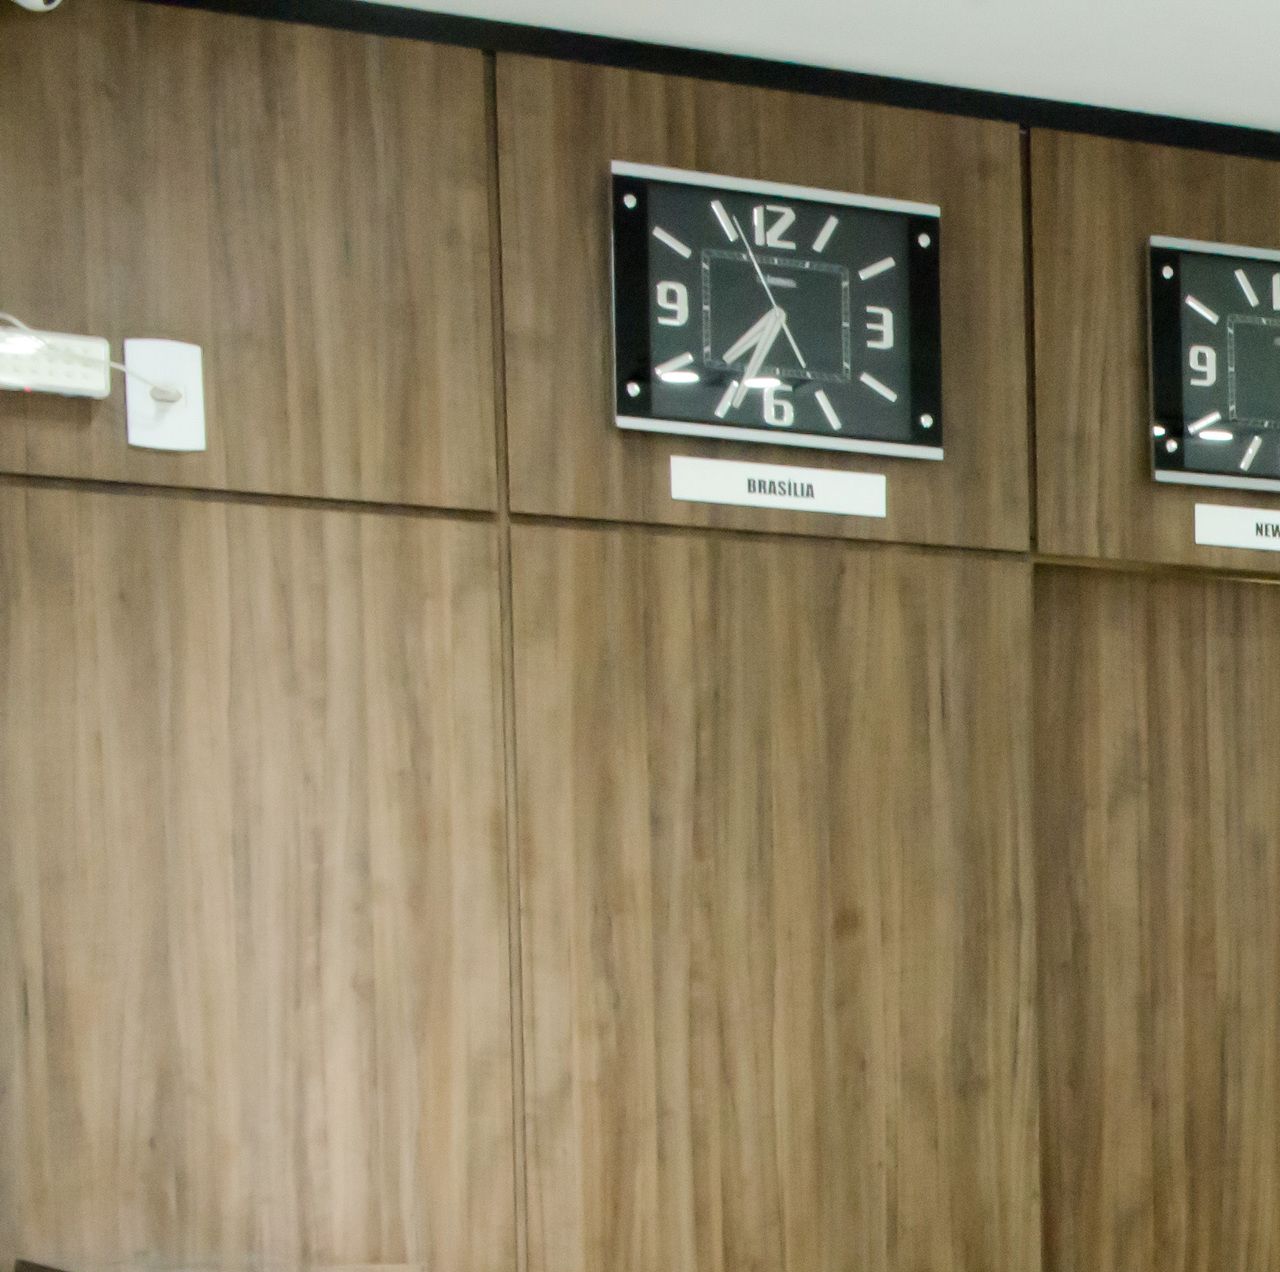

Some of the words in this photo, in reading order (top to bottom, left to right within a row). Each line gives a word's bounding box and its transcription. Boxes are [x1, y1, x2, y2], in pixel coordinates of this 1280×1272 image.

[753, 205, 796, 250] 12
[656, 280, 690, 326] 9
[866, 305, 894, 350] 3
[1189, 345, 1217, 387] 9
[763, 384, 795, 427] 6
